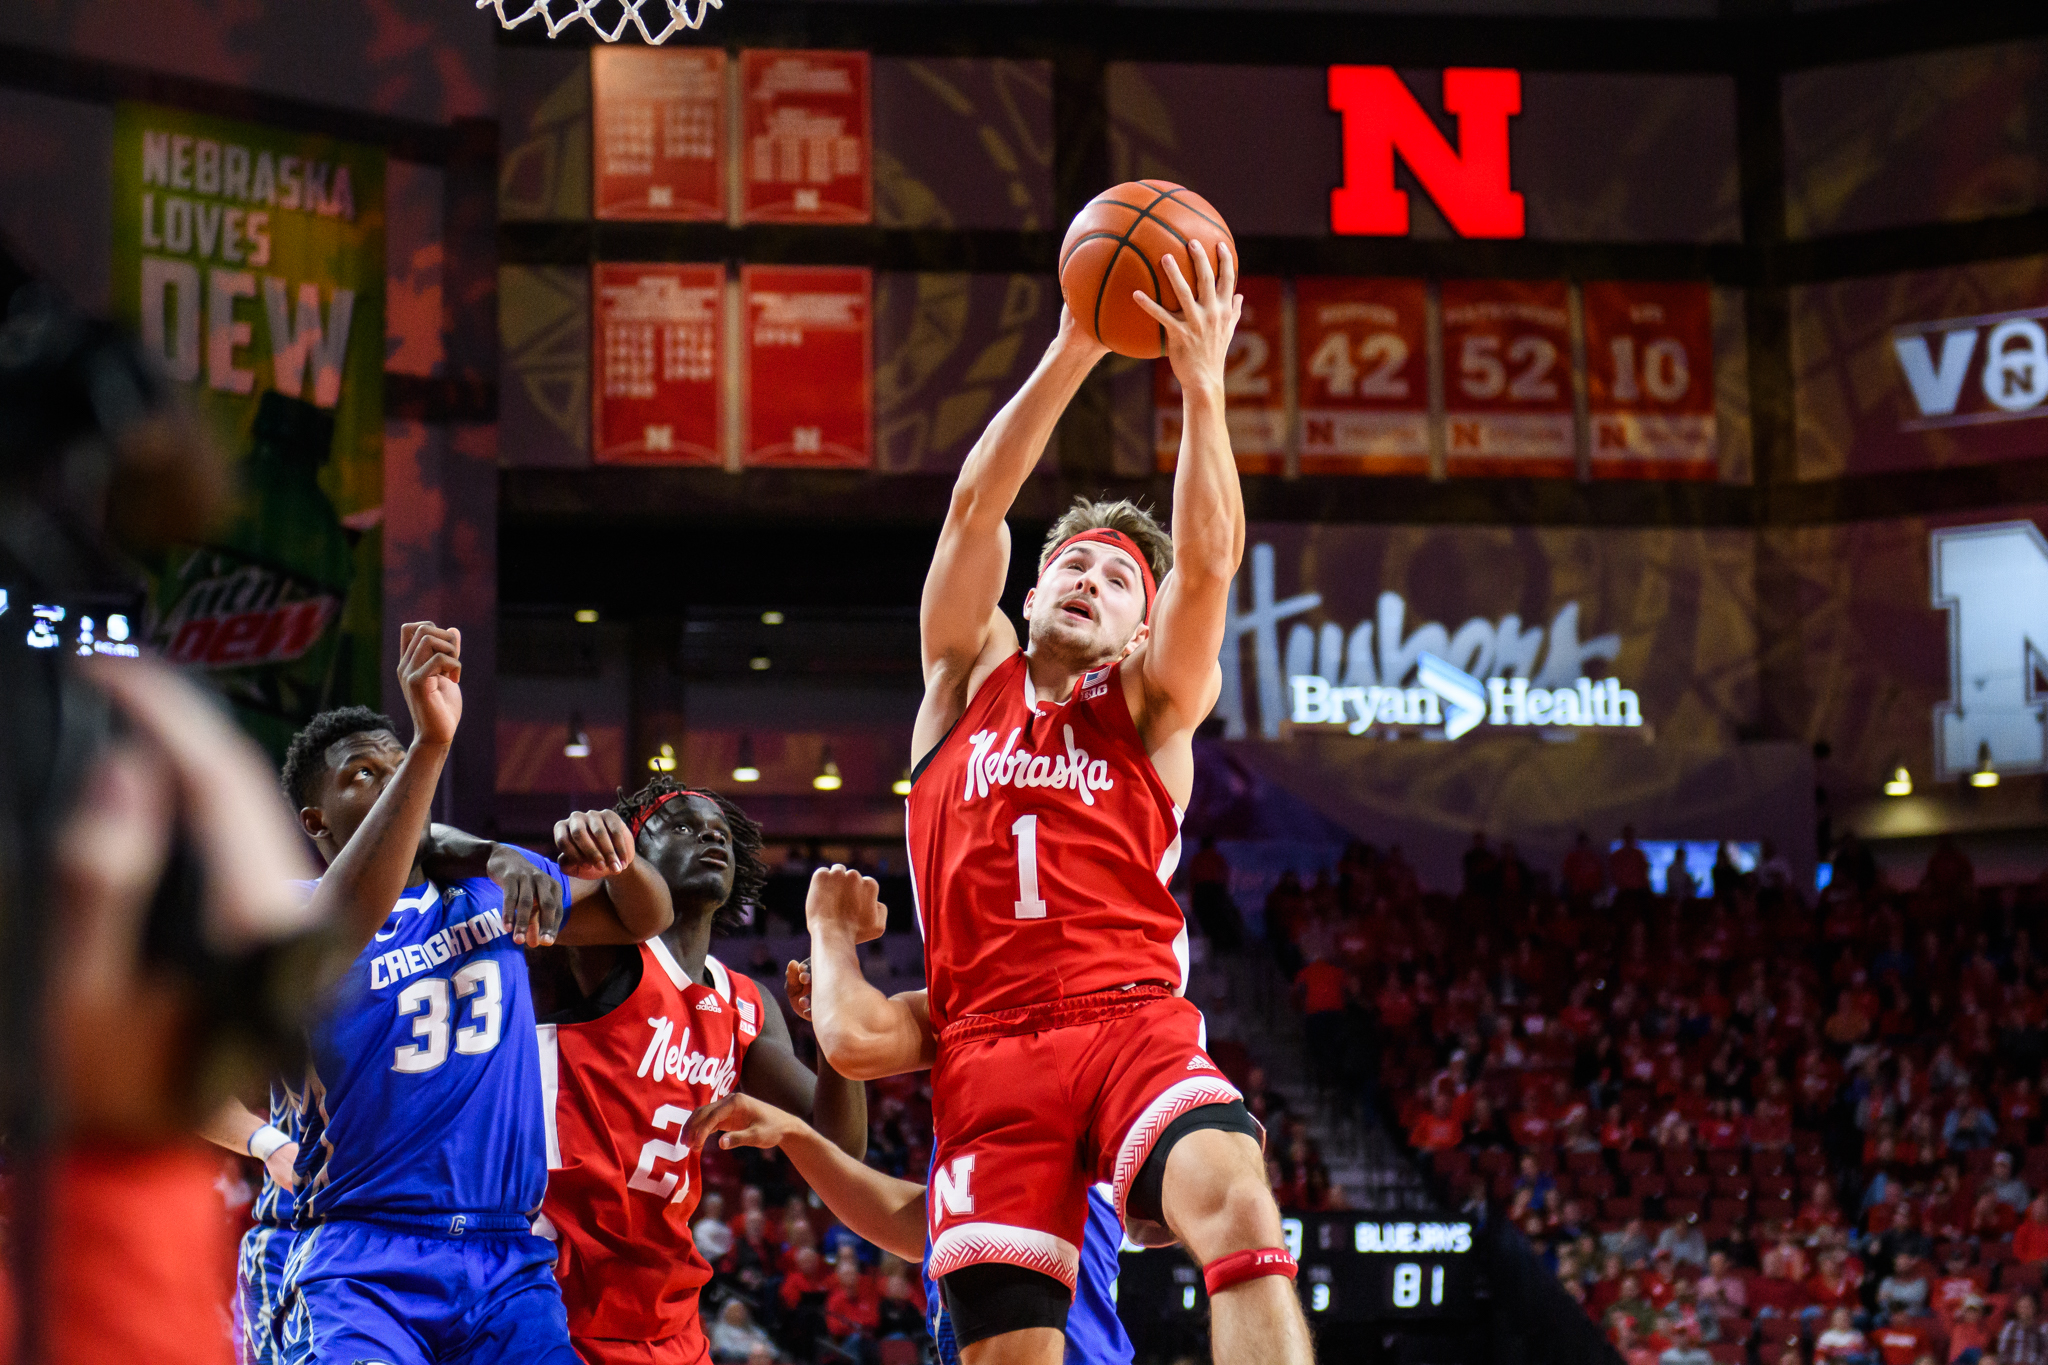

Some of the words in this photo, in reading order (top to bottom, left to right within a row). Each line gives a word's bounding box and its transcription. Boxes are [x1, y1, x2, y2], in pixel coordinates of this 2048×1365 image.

[142, 130, 356, 222] NEBRASKA
[1327, 64, 1525, 240] N
[141, 194, 271, 267] LOVES
[140, 255, 356, 408] DEW
[1309, 331, 1410, 397] 42
[1459, 335, 1558, 400] 52
[1610, 335, 1690, 403] 10
[1290, 674, 1442, 736] Bryan
[1487, 676, 1643, 727] Health
[963, 723, 1114, 806] Nebraska
[1011, 814, 1047, 919] 1
[370, 907, 510, 990] CREIGHTON
[390, 959, 502, 1074] 33
[449, 1215, 467, 1236] C
[933, 1154, 976, 1227] N
[1354, 1221, 1473, 1254] BLUEJAYS
[1392, 1262, 1445, 1308] 81
